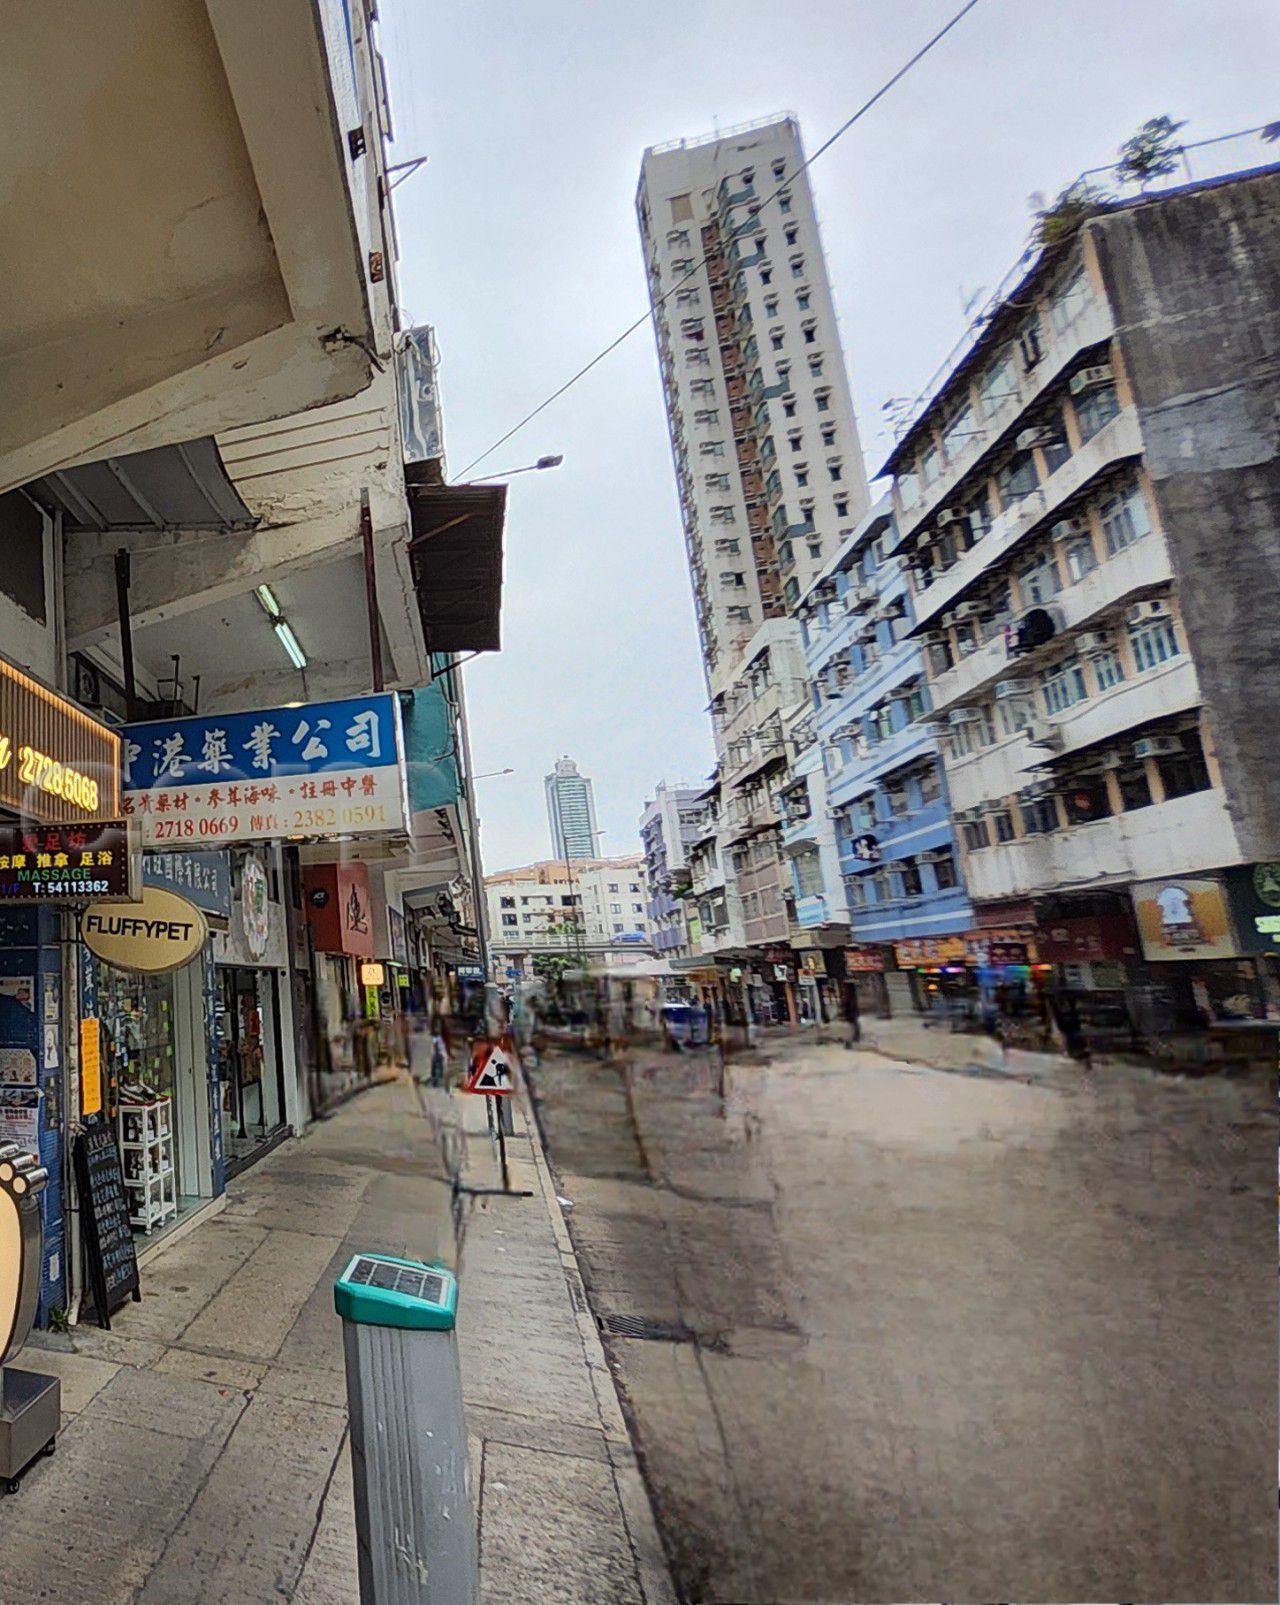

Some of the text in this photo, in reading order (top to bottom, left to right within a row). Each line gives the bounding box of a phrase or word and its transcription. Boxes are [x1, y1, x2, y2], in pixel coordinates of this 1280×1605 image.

[155, 819, 194, 839] 2718
[198, 815, 239, 836] 0669
[294, 808, 337, 829] 2382
[342, 804, 387, 825] 0591
[36, 852, 69, 868] 推拿
[80, 850, 112, 867] 足浴
[17, 868, 91, 882] MASSAGE
[86, 915, 193, 942] FLUFFYPET
